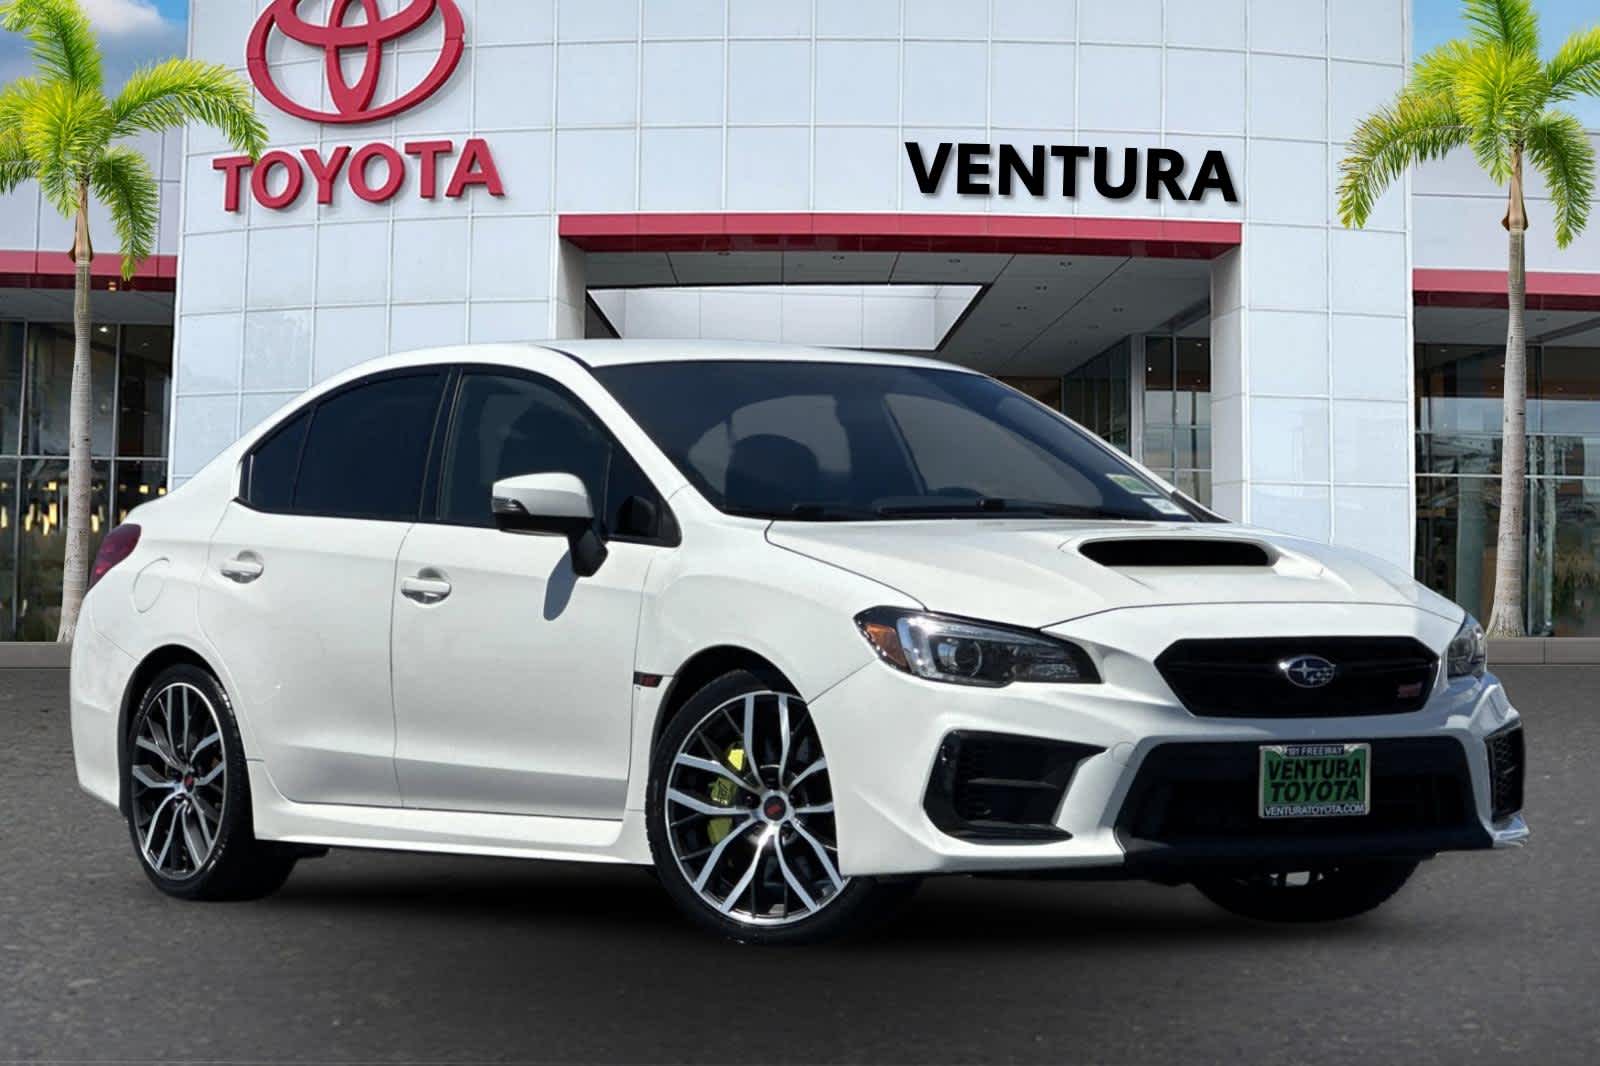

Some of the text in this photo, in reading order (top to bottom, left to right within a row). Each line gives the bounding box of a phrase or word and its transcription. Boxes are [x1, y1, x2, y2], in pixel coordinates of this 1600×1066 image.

[212, 139, 504, 212] TOYOTA
[904, 141, 1239, 203] VENTURA
[1268, 759, 1361, 780] VENTURA
[1270, 780, 1360, 802] TOYOTA
[1265, 804, 1365, 816] VENTURATOYOTA.COM
